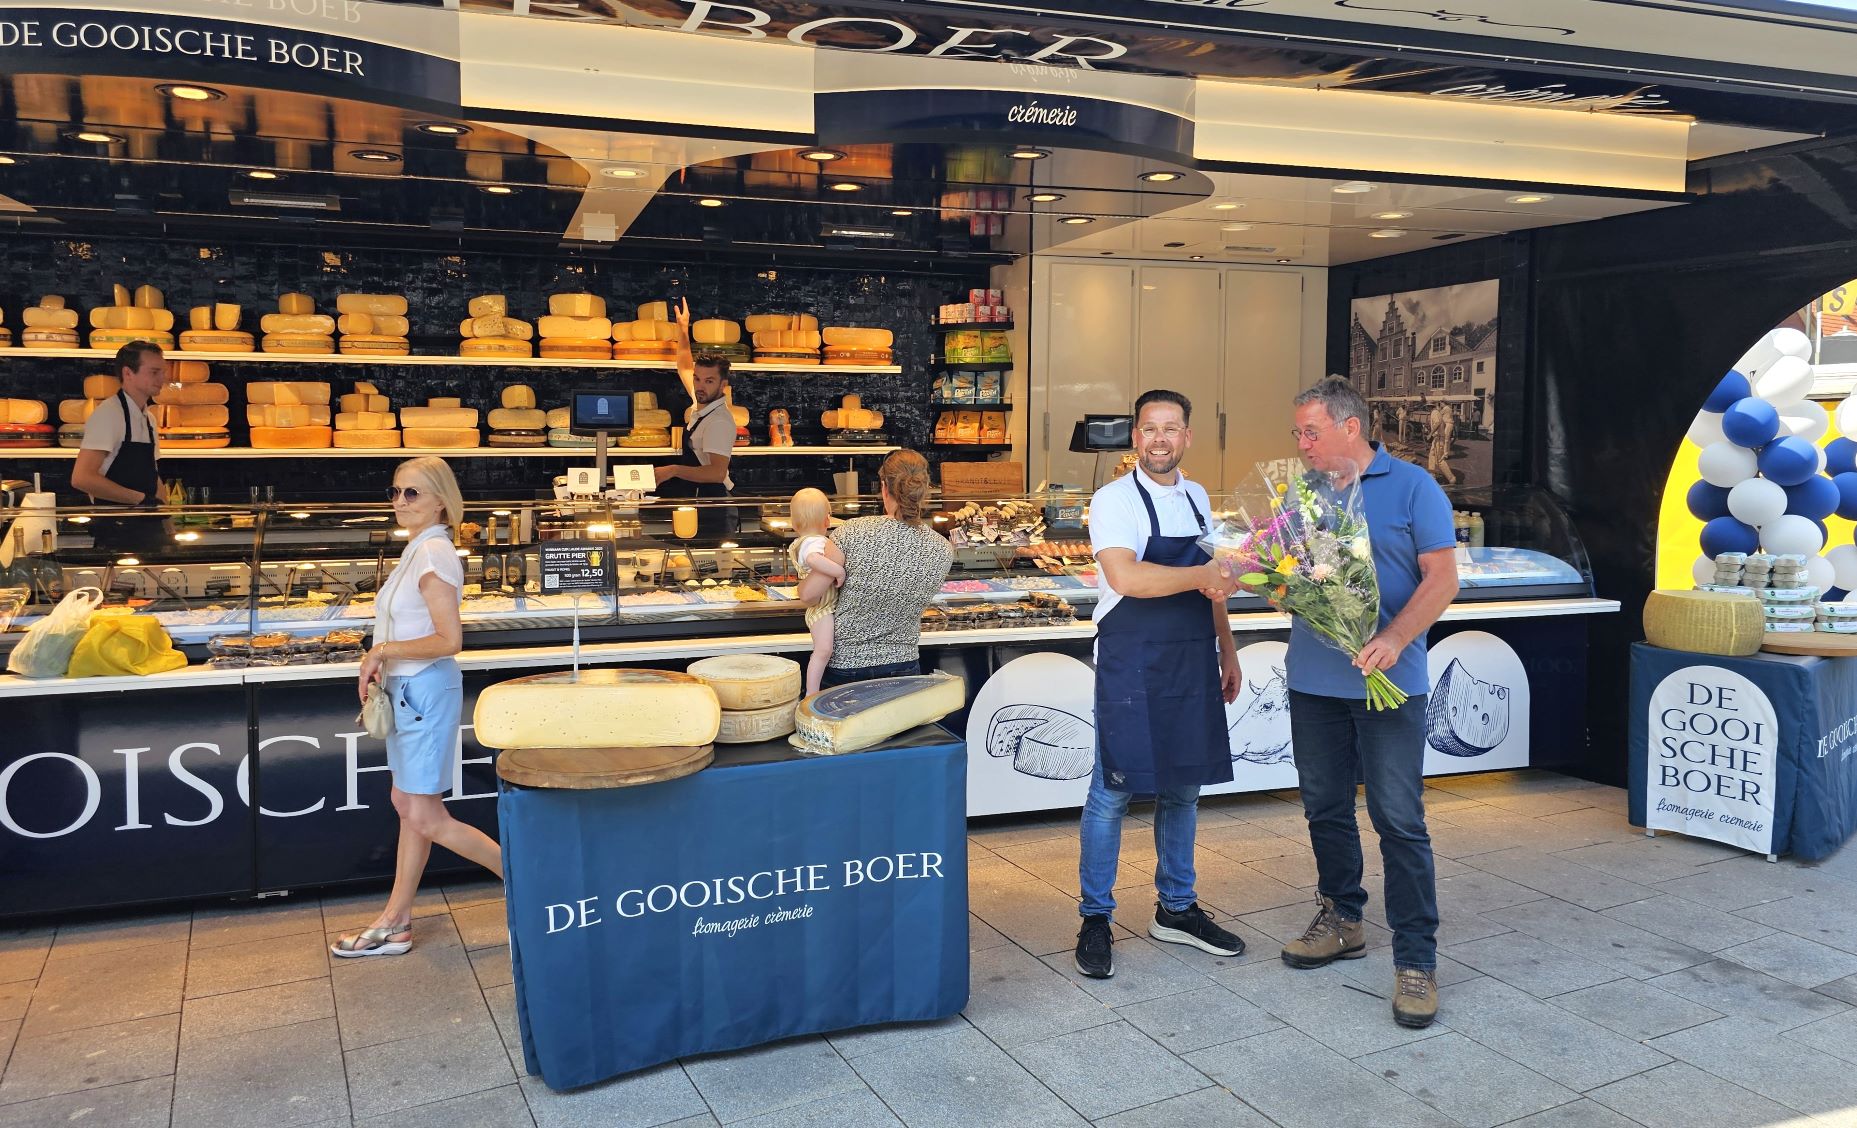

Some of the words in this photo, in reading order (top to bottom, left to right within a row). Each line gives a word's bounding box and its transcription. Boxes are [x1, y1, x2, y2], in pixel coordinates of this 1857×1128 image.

[0, 22, 43, 47] DE
[52, 22, 257, 61] GOOISCHE
[268, 39, 365, 76] BOER
[1007, 100, 1077, 126] crémerie
[581, 569, 603, 578] 12,50
[1687, 682, 1739, 711] DE
[1661, 708, 1764, 746] GOOI
[1660, 736, 1763, 776] SCHE
[1658, 764, 1761, 806] BOER
[1656, 797, 1714, 821] fromagerie
[545, 895, 602, 934] DE
[616, 864, 830, 918] GOOISCHE
[843, 852, 944, 888] BOER
[692, 913, 759, 938] fromagerie
[764, 904, 814, 925] crèmerie
